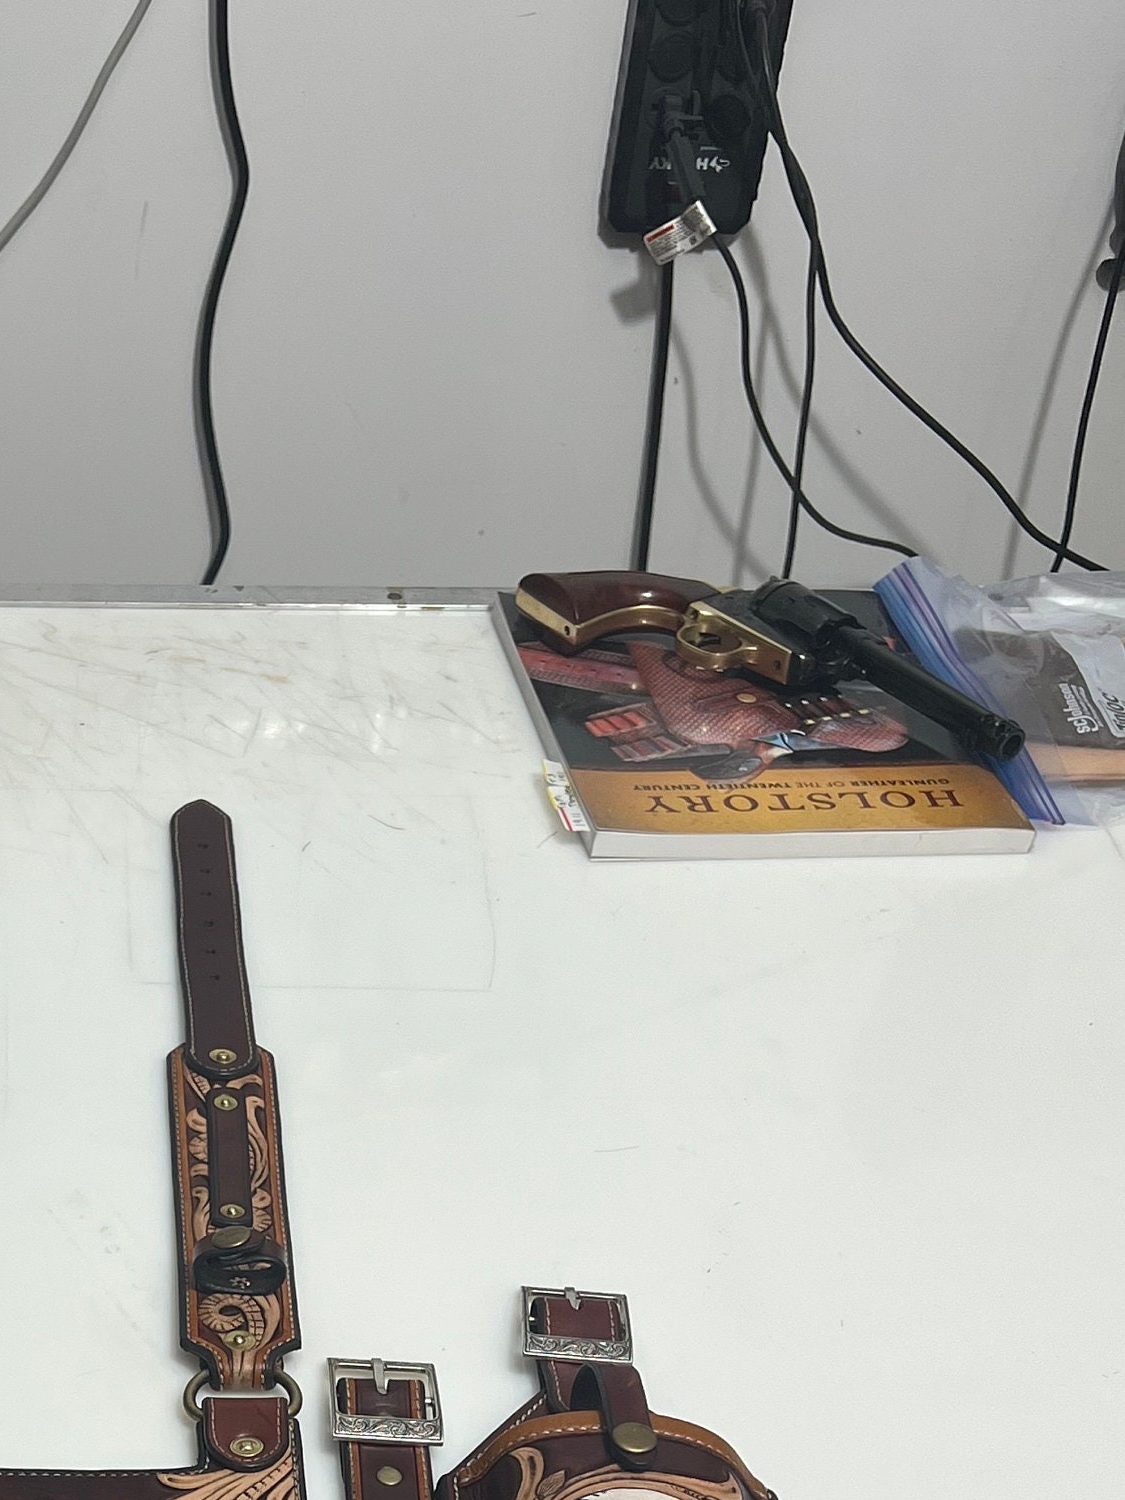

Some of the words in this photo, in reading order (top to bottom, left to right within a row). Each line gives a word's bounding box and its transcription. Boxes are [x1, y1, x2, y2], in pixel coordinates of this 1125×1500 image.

[706, 781, 791, 790] TWENTIETH
[795, 780, 822, 789] THE
[827, 780, 847, 789] OF
[850, 778, 950, 788] GUNLEATHER
[633, 784, 703, 792] CENTURY
[645, 790, 965, 813] HOLSTORY
